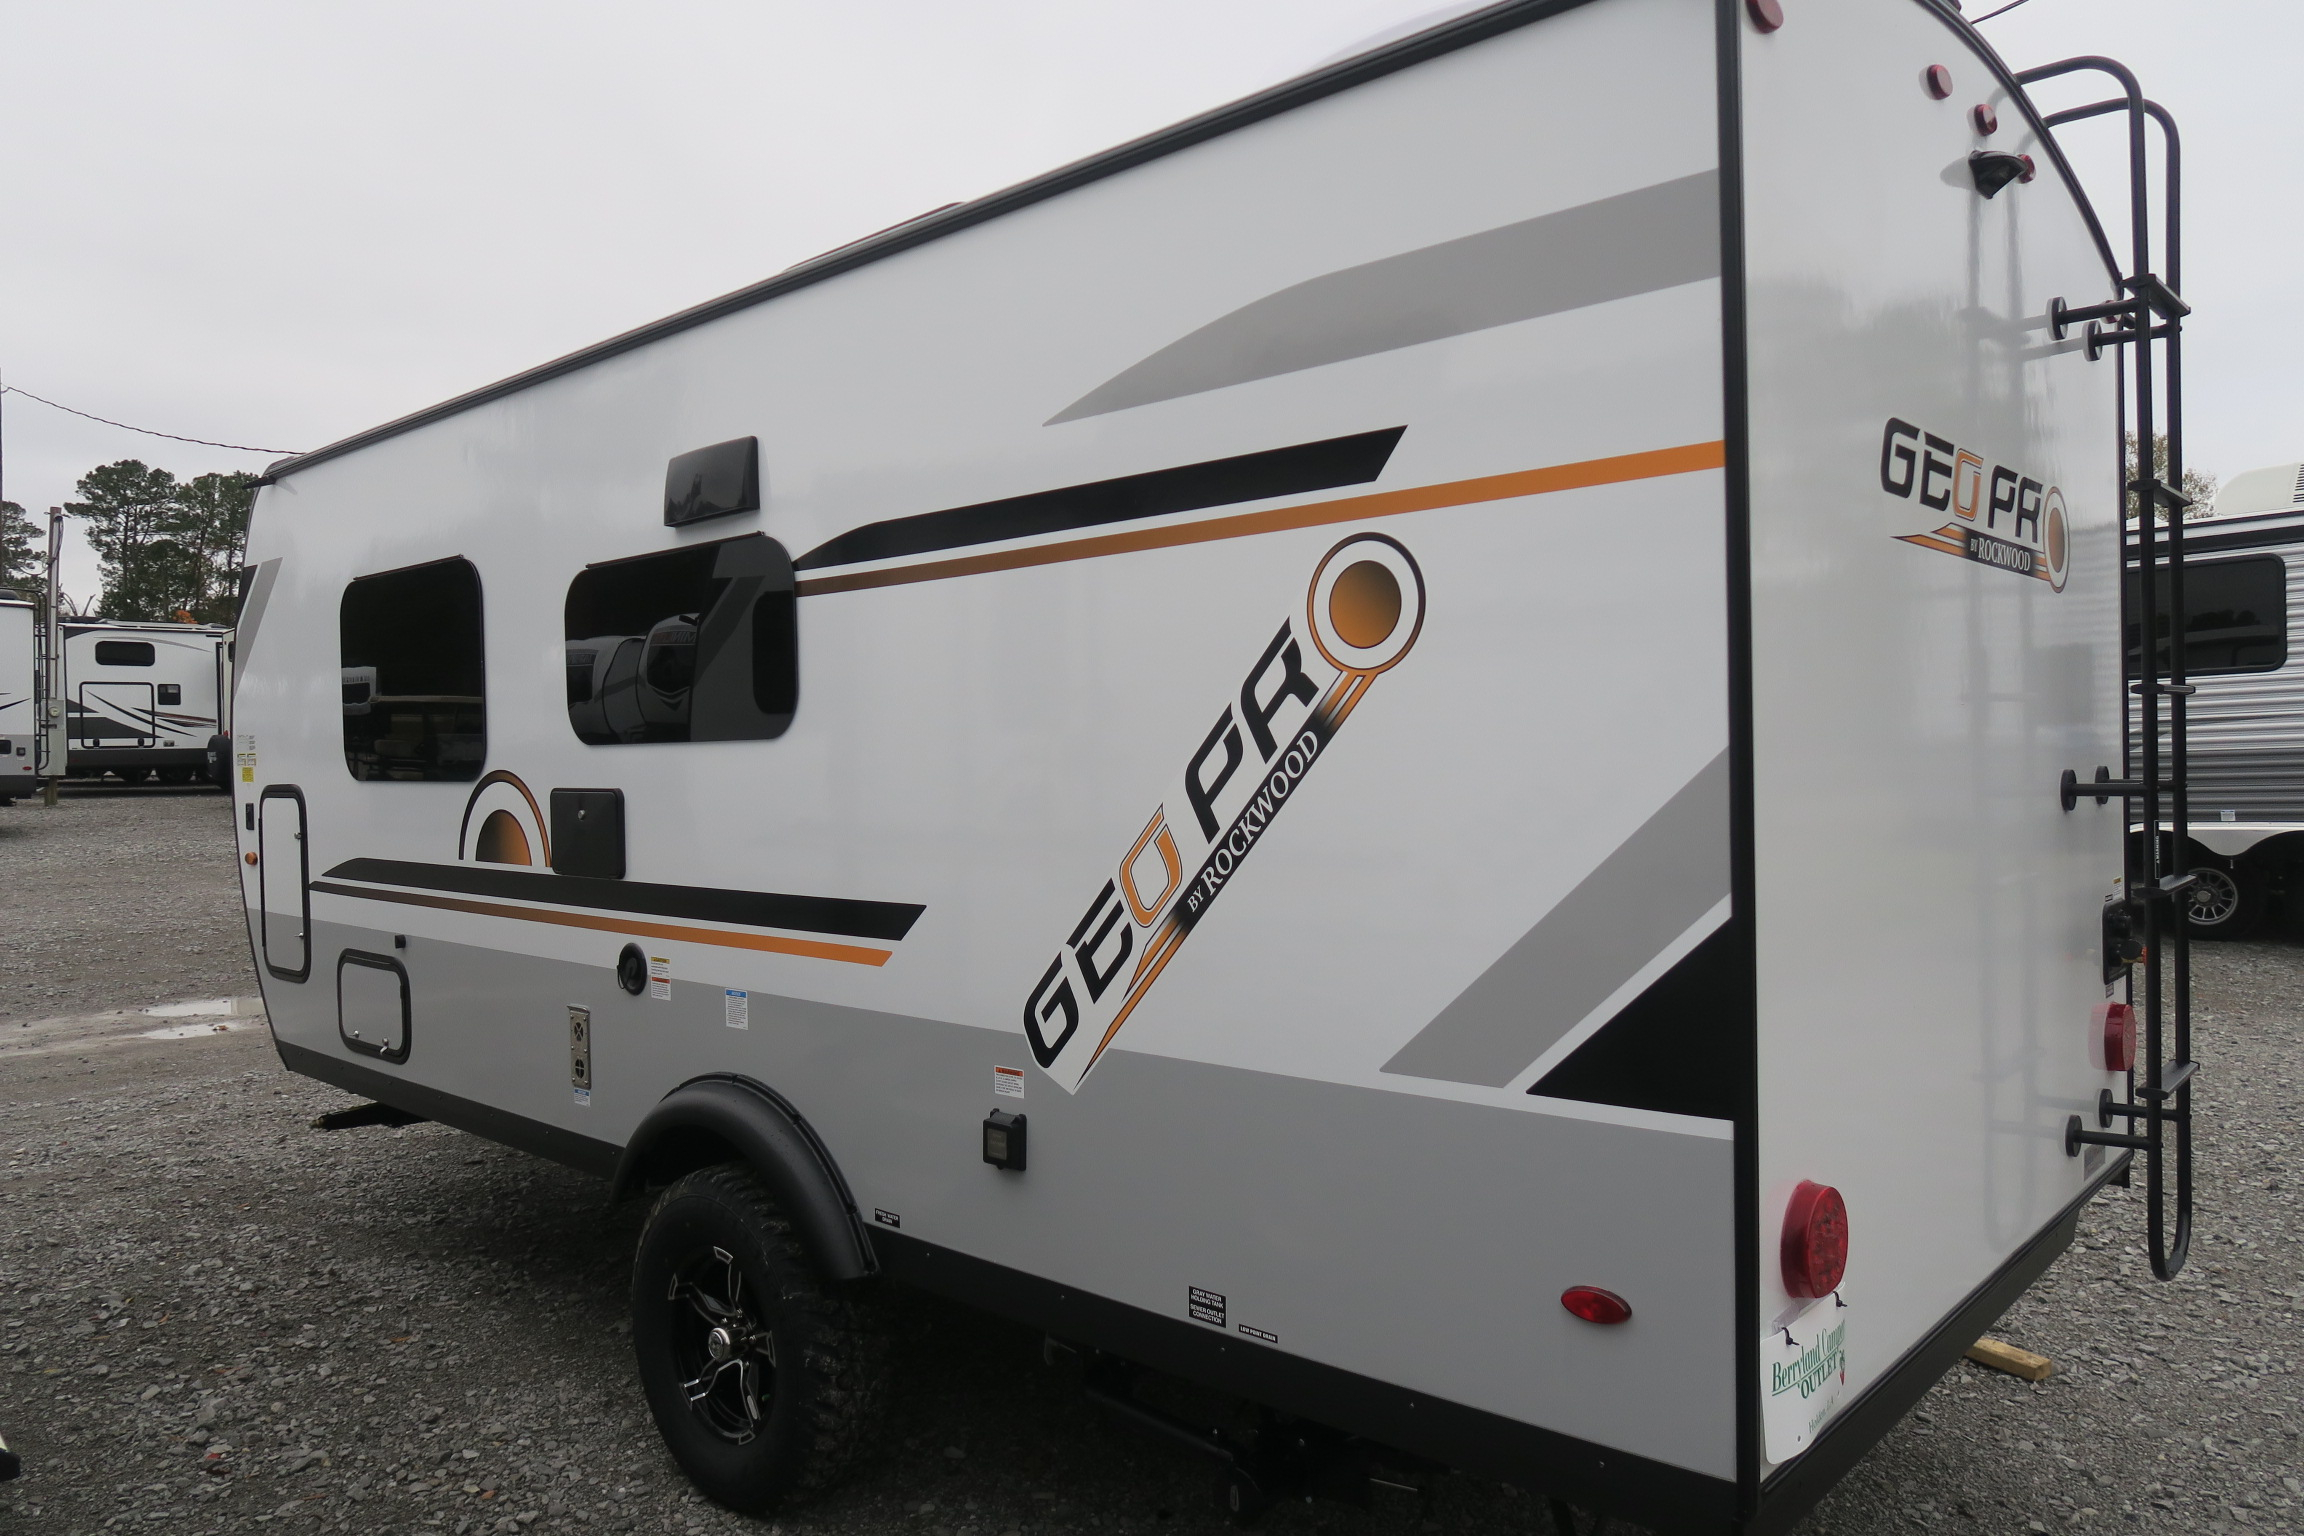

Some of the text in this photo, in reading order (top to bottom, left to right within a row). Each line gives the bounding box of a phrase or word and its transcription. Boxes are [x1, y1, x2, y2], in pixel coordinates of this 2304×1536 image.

[1880, 417, 1985, 522] GEO
[1970, 537, 2031, 571] BY ROCKWOOD
[1186, 730, 1318, 913] BY ROCKWOOD
[1023, 801, 1182, 1069] GEO
[1189, 1303, 1225, 1319] SEWER OUTLET
[1190, 1293, 1224, 1309] HOLDING TANK
[1192, 1288, 1222, 1302] GRAY WATER
[1192, 1310, 1222, 1324] CONNECTION
[1772, 1333, 1821, 1392] Berryland
[1800, 1350, 1837, 1399] OUTLET
